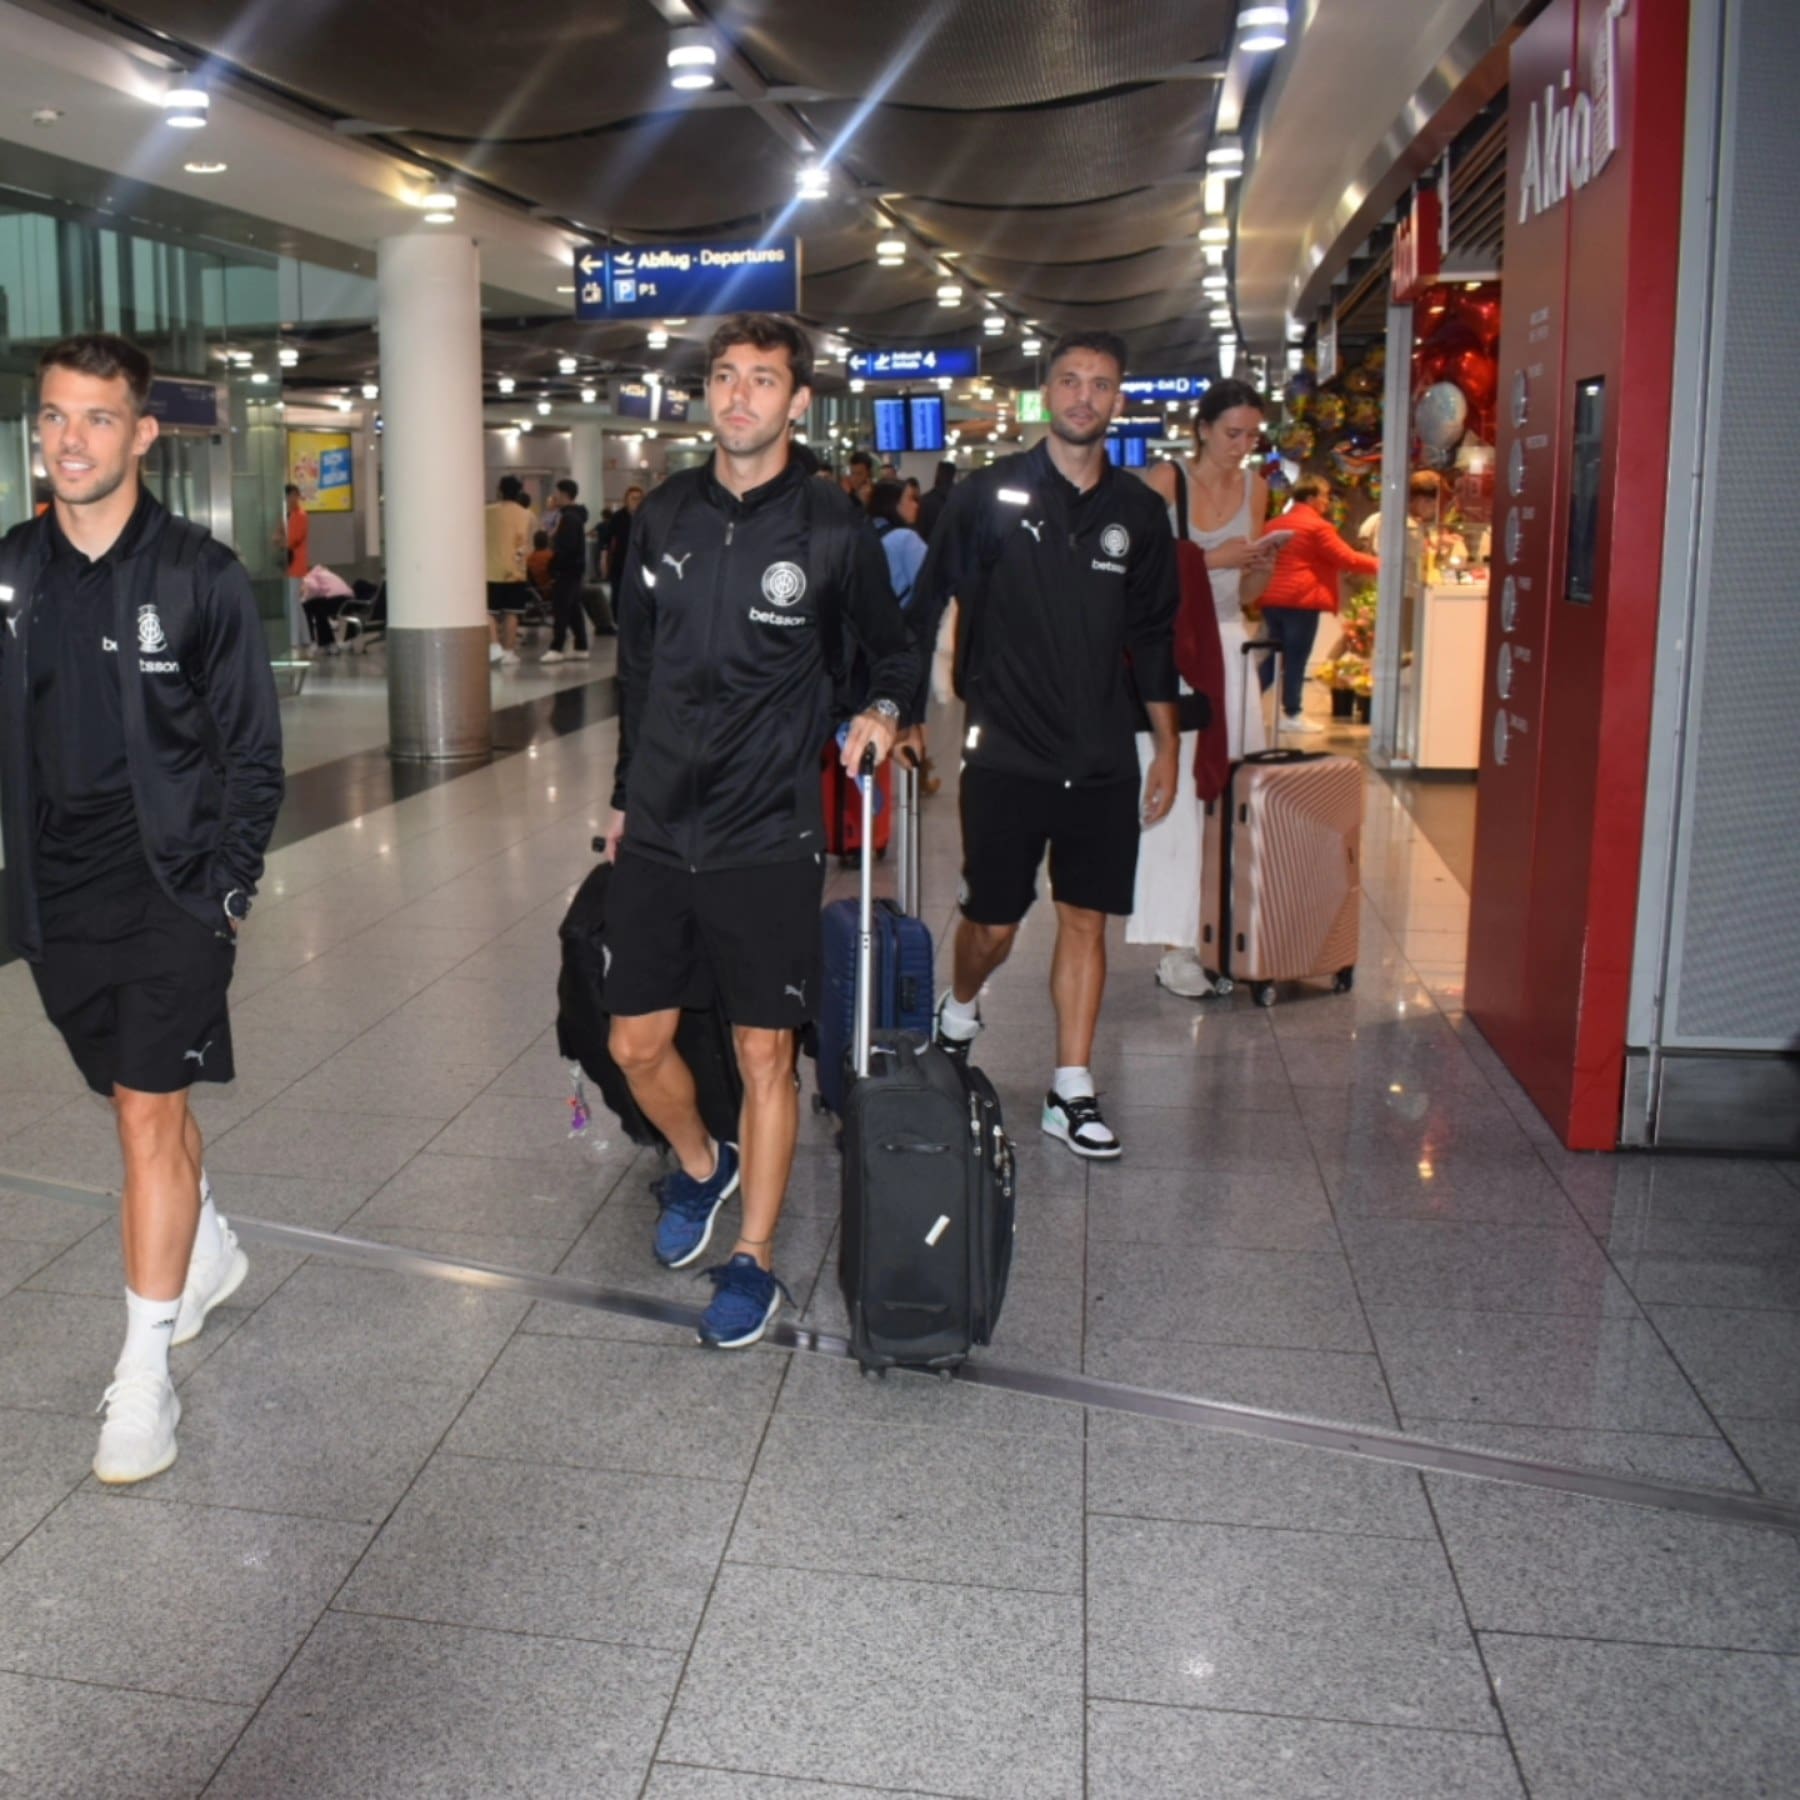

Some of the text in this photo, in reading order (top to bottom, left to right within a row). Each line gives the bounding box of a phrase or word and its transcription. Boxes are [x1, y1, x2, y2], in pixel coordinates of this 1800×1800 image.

[637, 249, 786, 271] Abflug Departures
[638, 283, 657, 296] P1
[922, 350, 937, 369] 4
